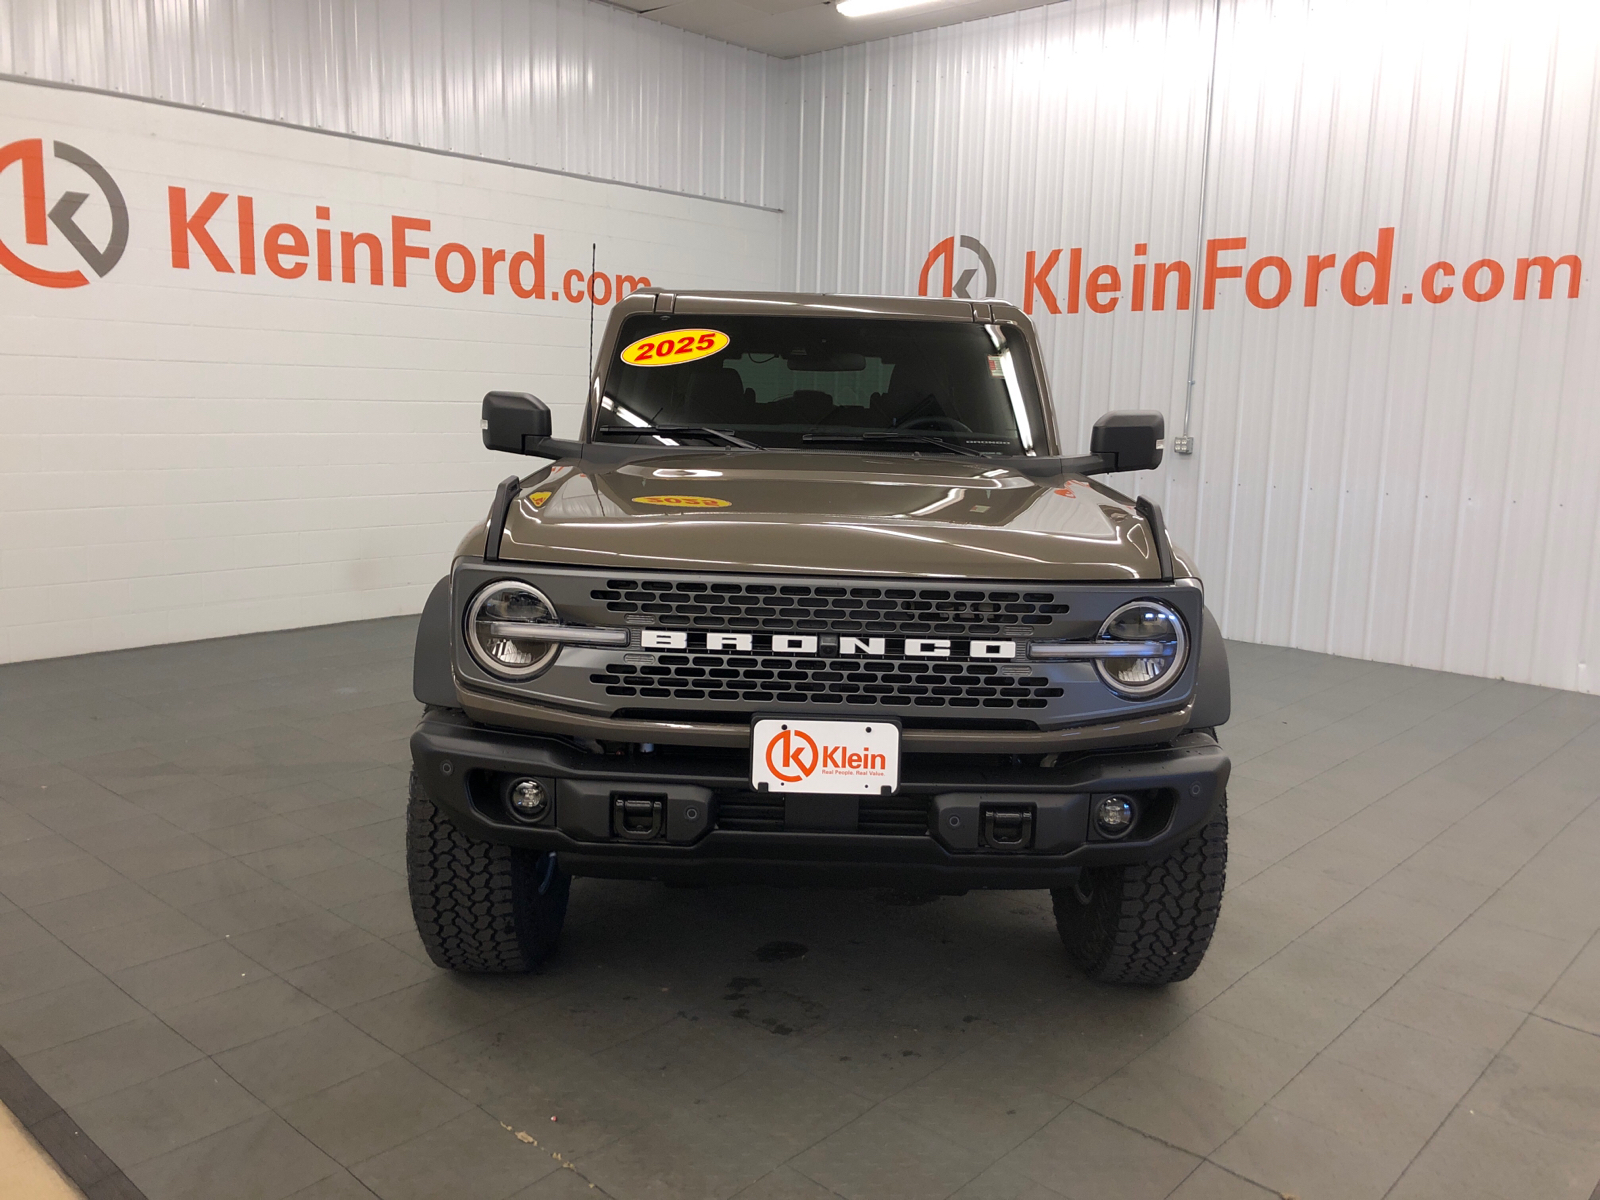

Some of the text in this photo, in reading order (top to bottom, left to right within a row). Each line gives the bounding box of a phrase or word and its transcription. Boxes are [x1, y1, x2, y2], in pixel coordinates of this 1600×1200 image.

[168, 185, 651, 306] KleinFord.com
[1023, 226, 1582, 315] KleinFord.com
[634, 333, 716, 361] 2025
[641, 629, 1016, 658] BRONCO
[822, 745, 886, 770] Klein
